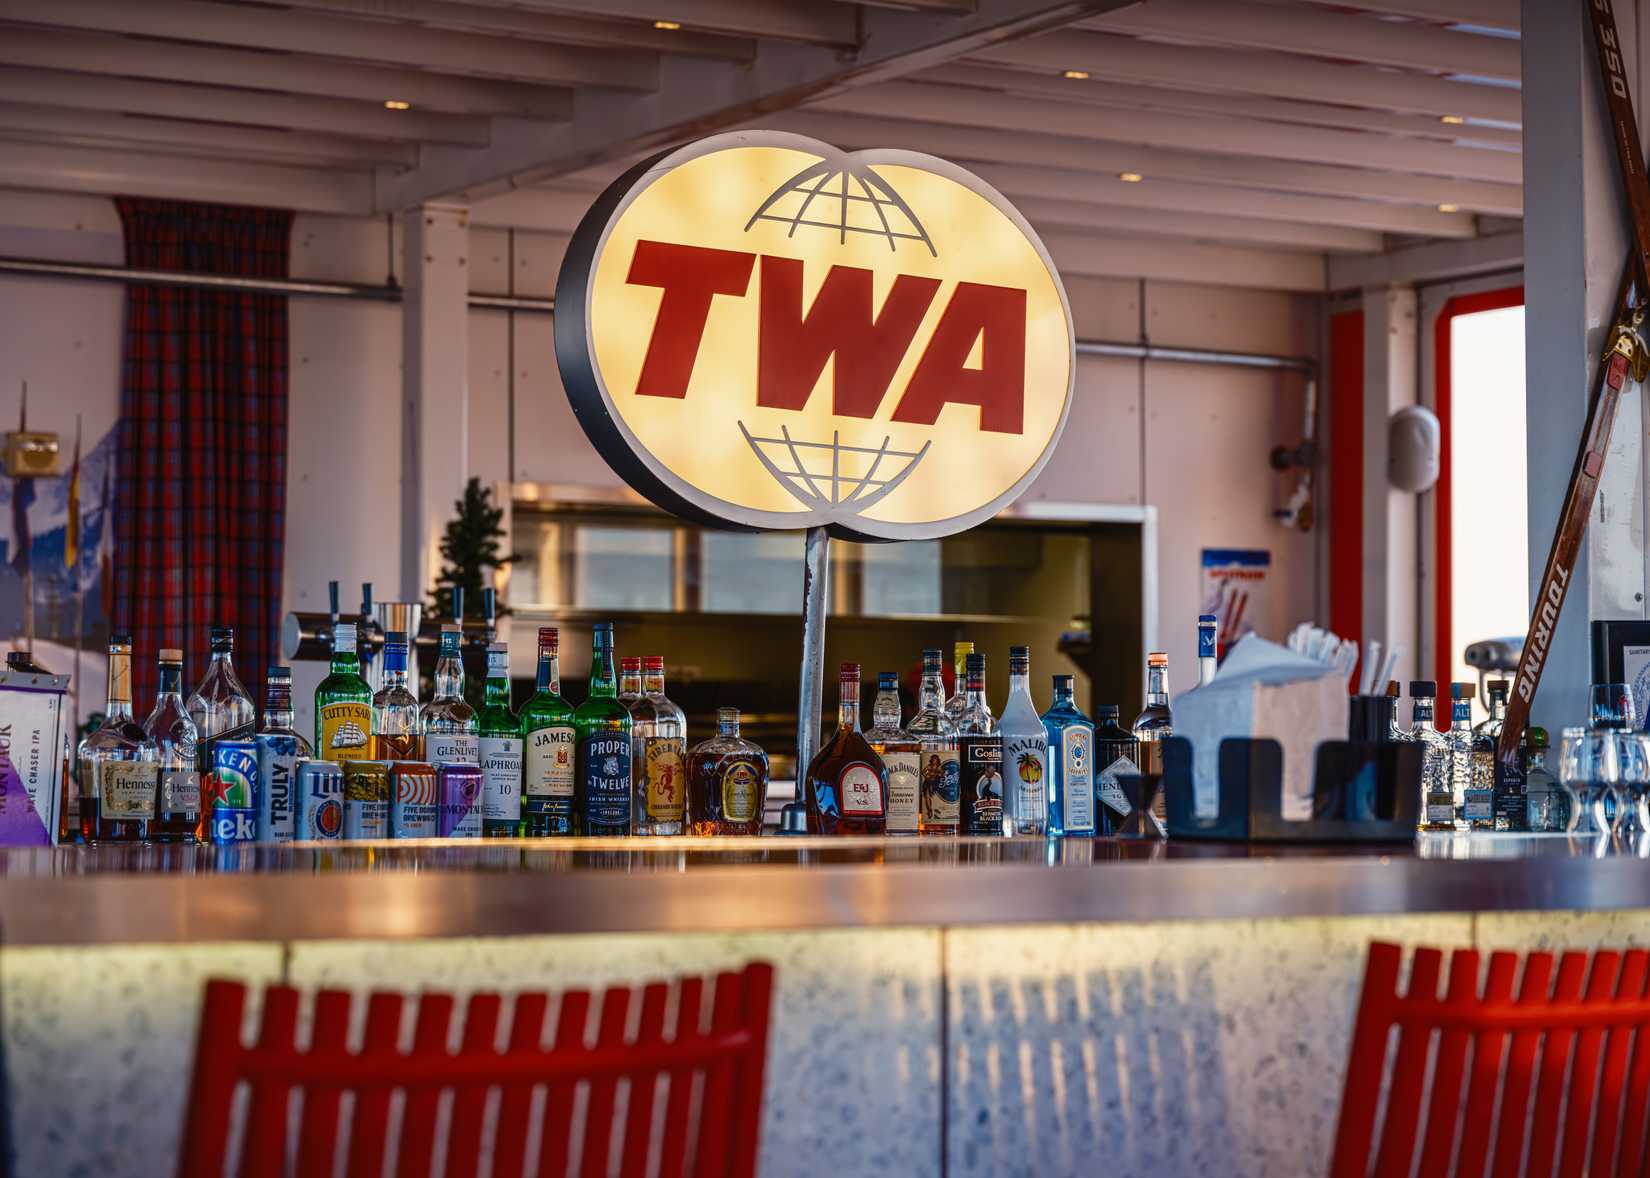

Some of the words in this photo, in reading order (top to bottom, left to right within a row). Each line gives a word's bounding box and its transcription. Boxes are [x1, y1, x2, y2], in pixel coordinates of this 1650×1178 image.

[1600, 24, 1627, 99] 350
[625, 239, 1027, 435] TWA
[1518, 563, 1569, 703] TOURING
[323, 706, 353, 720] CUTTY
[354, 706, 370, 720] SAR
[1455, 708, 1470, 718] ALT
[32, 729, 40, 744] IPA
[535, 732, 576, 747] JAMESO
[590, 740, 630, 757] PROPER
[29, 748, 39, 783] CHASER
[479, 760, 521, 770] LAPHROA
[499, 784, 512, 795] 10
[591, 775, 630, 790] TWELVE
[270, 763, 289, 825] TRULY
